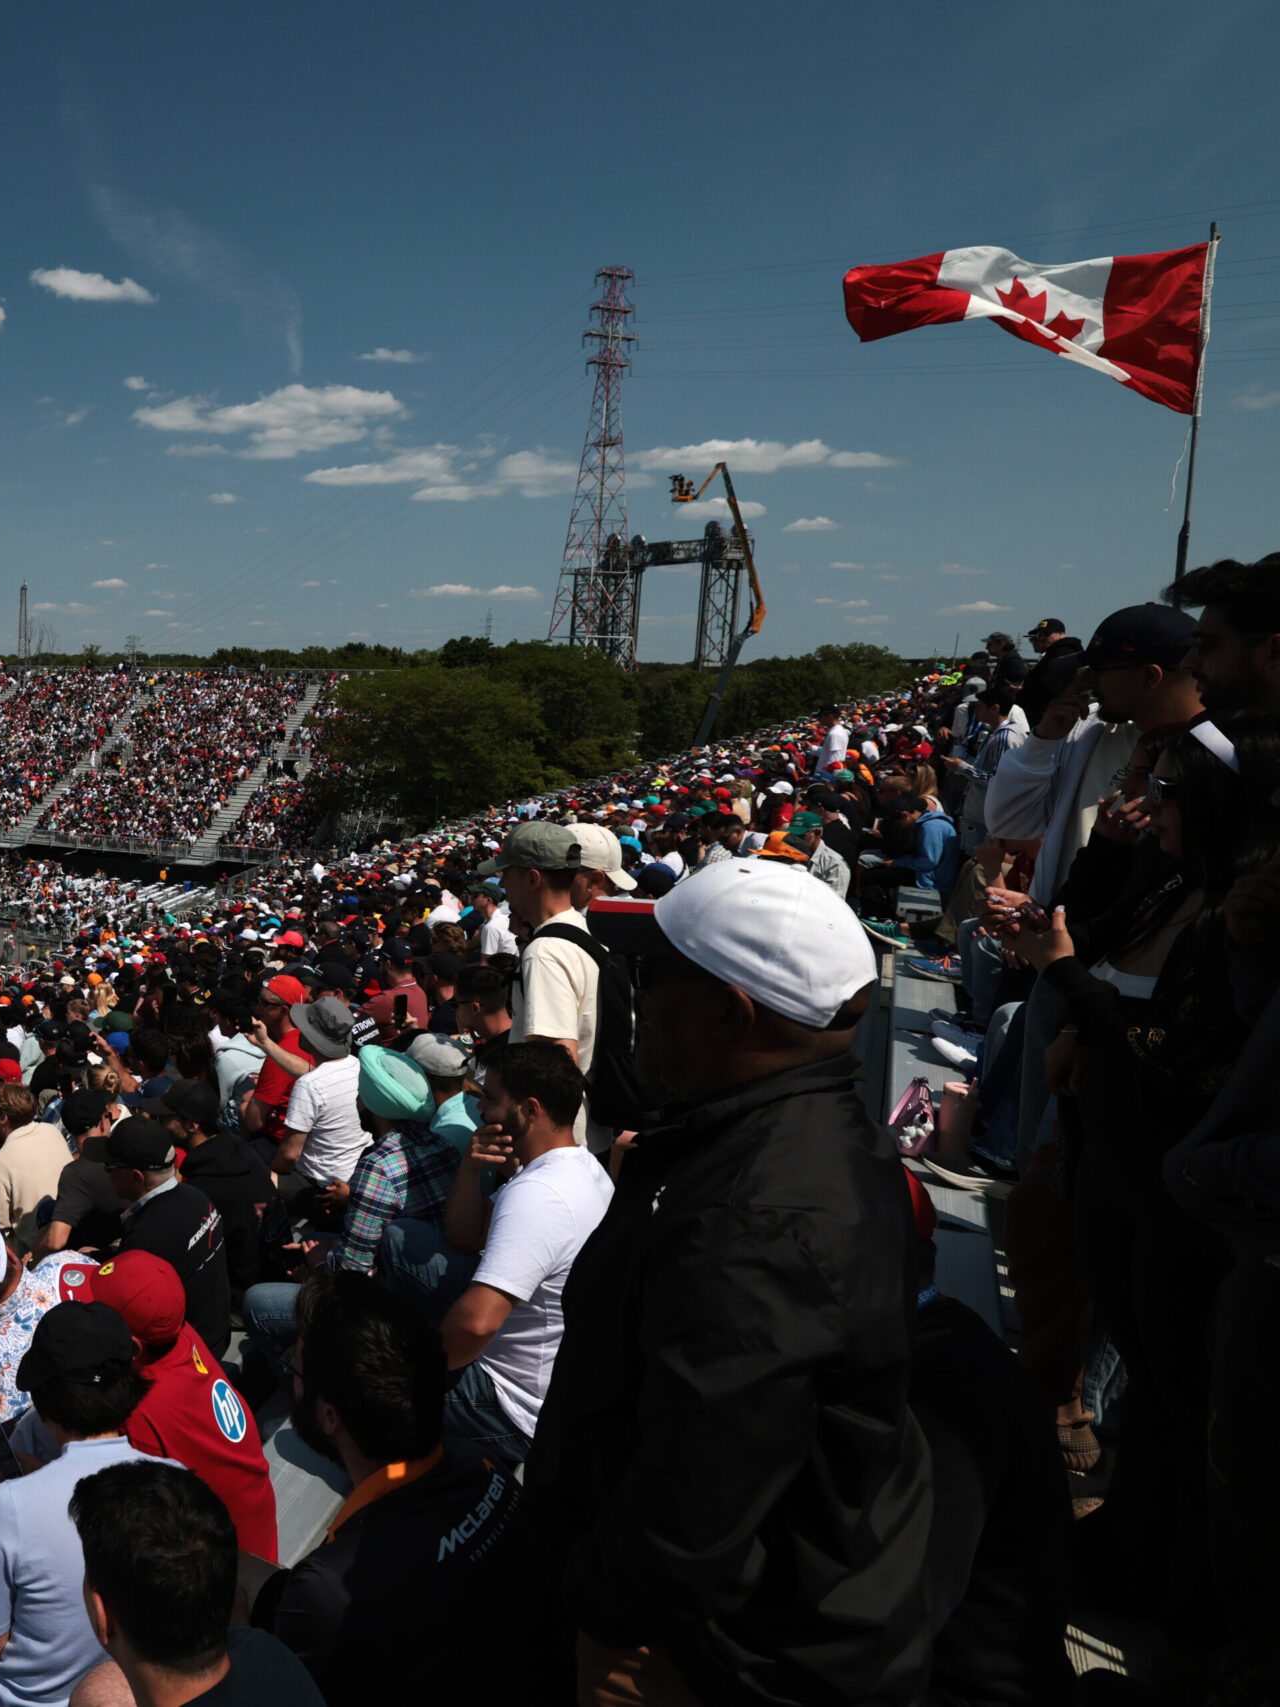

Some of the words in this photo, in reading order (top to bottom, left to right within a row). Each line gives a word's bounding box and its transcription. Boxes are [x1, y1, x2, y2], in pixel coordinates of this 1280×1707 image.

[351, 1016, 376, 1035] ETRON
[213, 1384, 244, 1440] hp
[437, 1471, 507, 1563] McLaren
